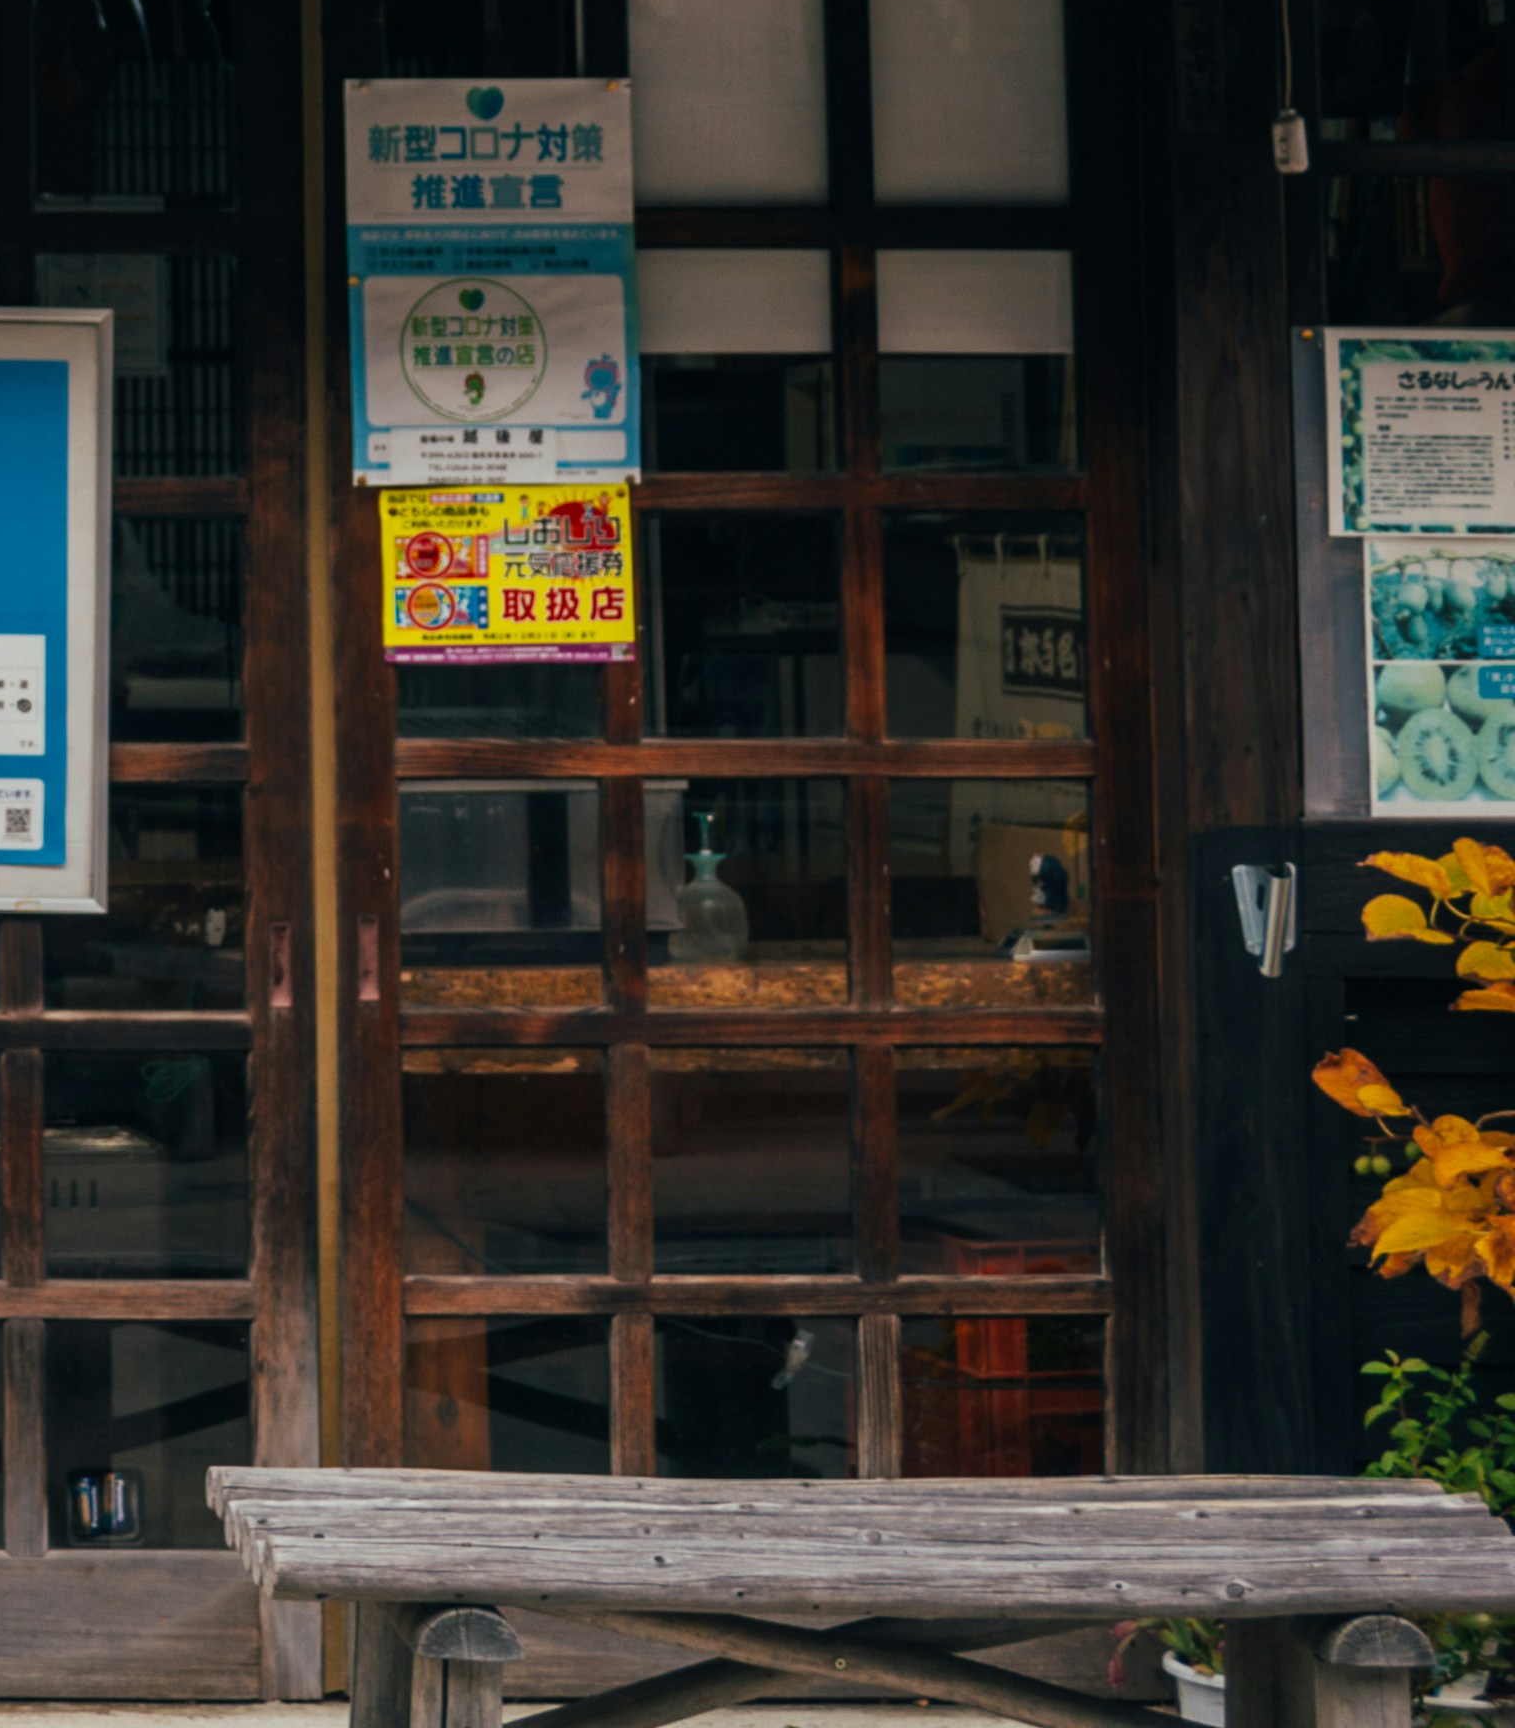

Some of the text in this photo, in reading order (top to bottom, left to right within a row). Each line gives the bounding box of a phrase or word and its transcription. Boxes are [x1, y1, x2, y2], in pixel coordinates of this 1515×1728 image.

[368, 122, 603, 163] 新型コロナ対策
[411, 174, 564, 210] 推進宣言
[411, 316, 534, 337] 新型コロナ対策
[413, 344, 536, 366] 推進宣言の店
[502, 587, 624, 622] 取扱店
